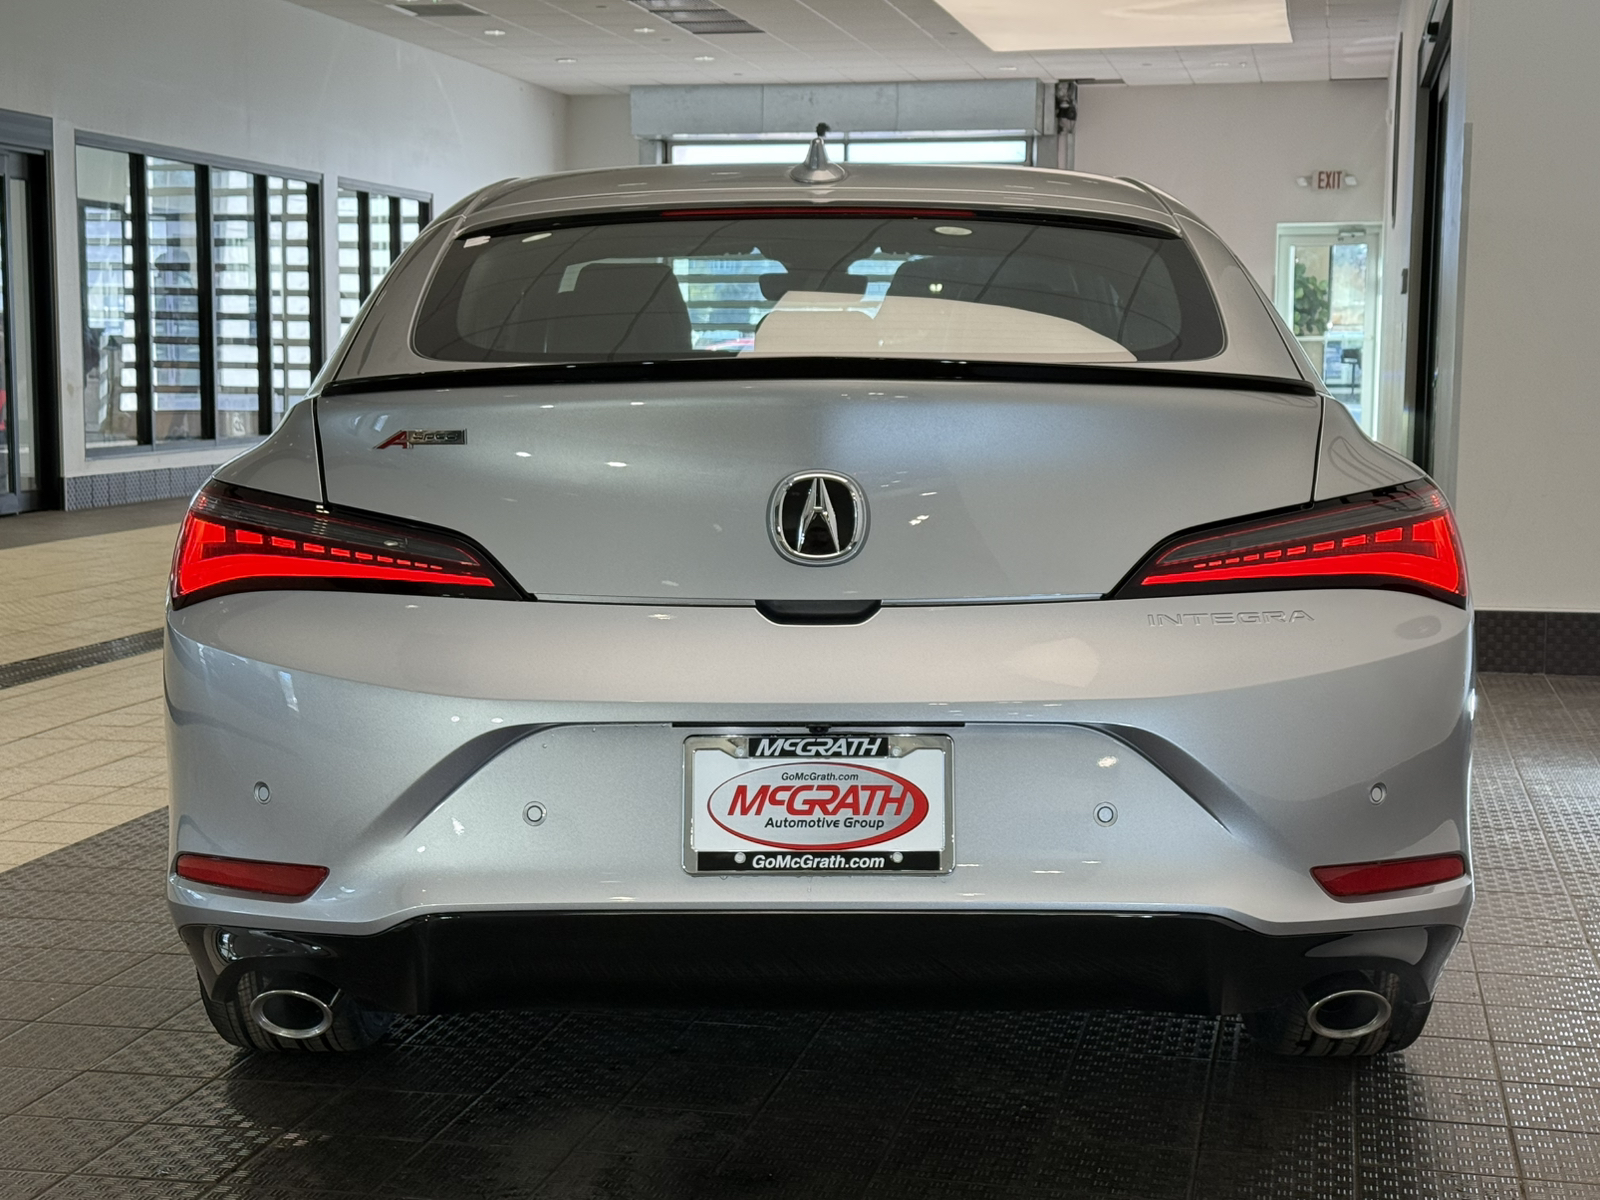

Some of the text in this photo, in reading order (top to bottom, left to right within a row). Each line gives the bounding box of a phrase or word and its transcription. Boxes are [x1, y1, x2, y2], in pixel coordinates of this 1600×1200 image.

[1317, 170, 1342, 190] EXIT
[1147, 609, 1315, 626] INTEGRA
[781, 771, 859, 782] GoMcGrath.com
[764, 817, 885, 830] Automotive Group
[751, 854, 885, 869] GoMcGrath.com
